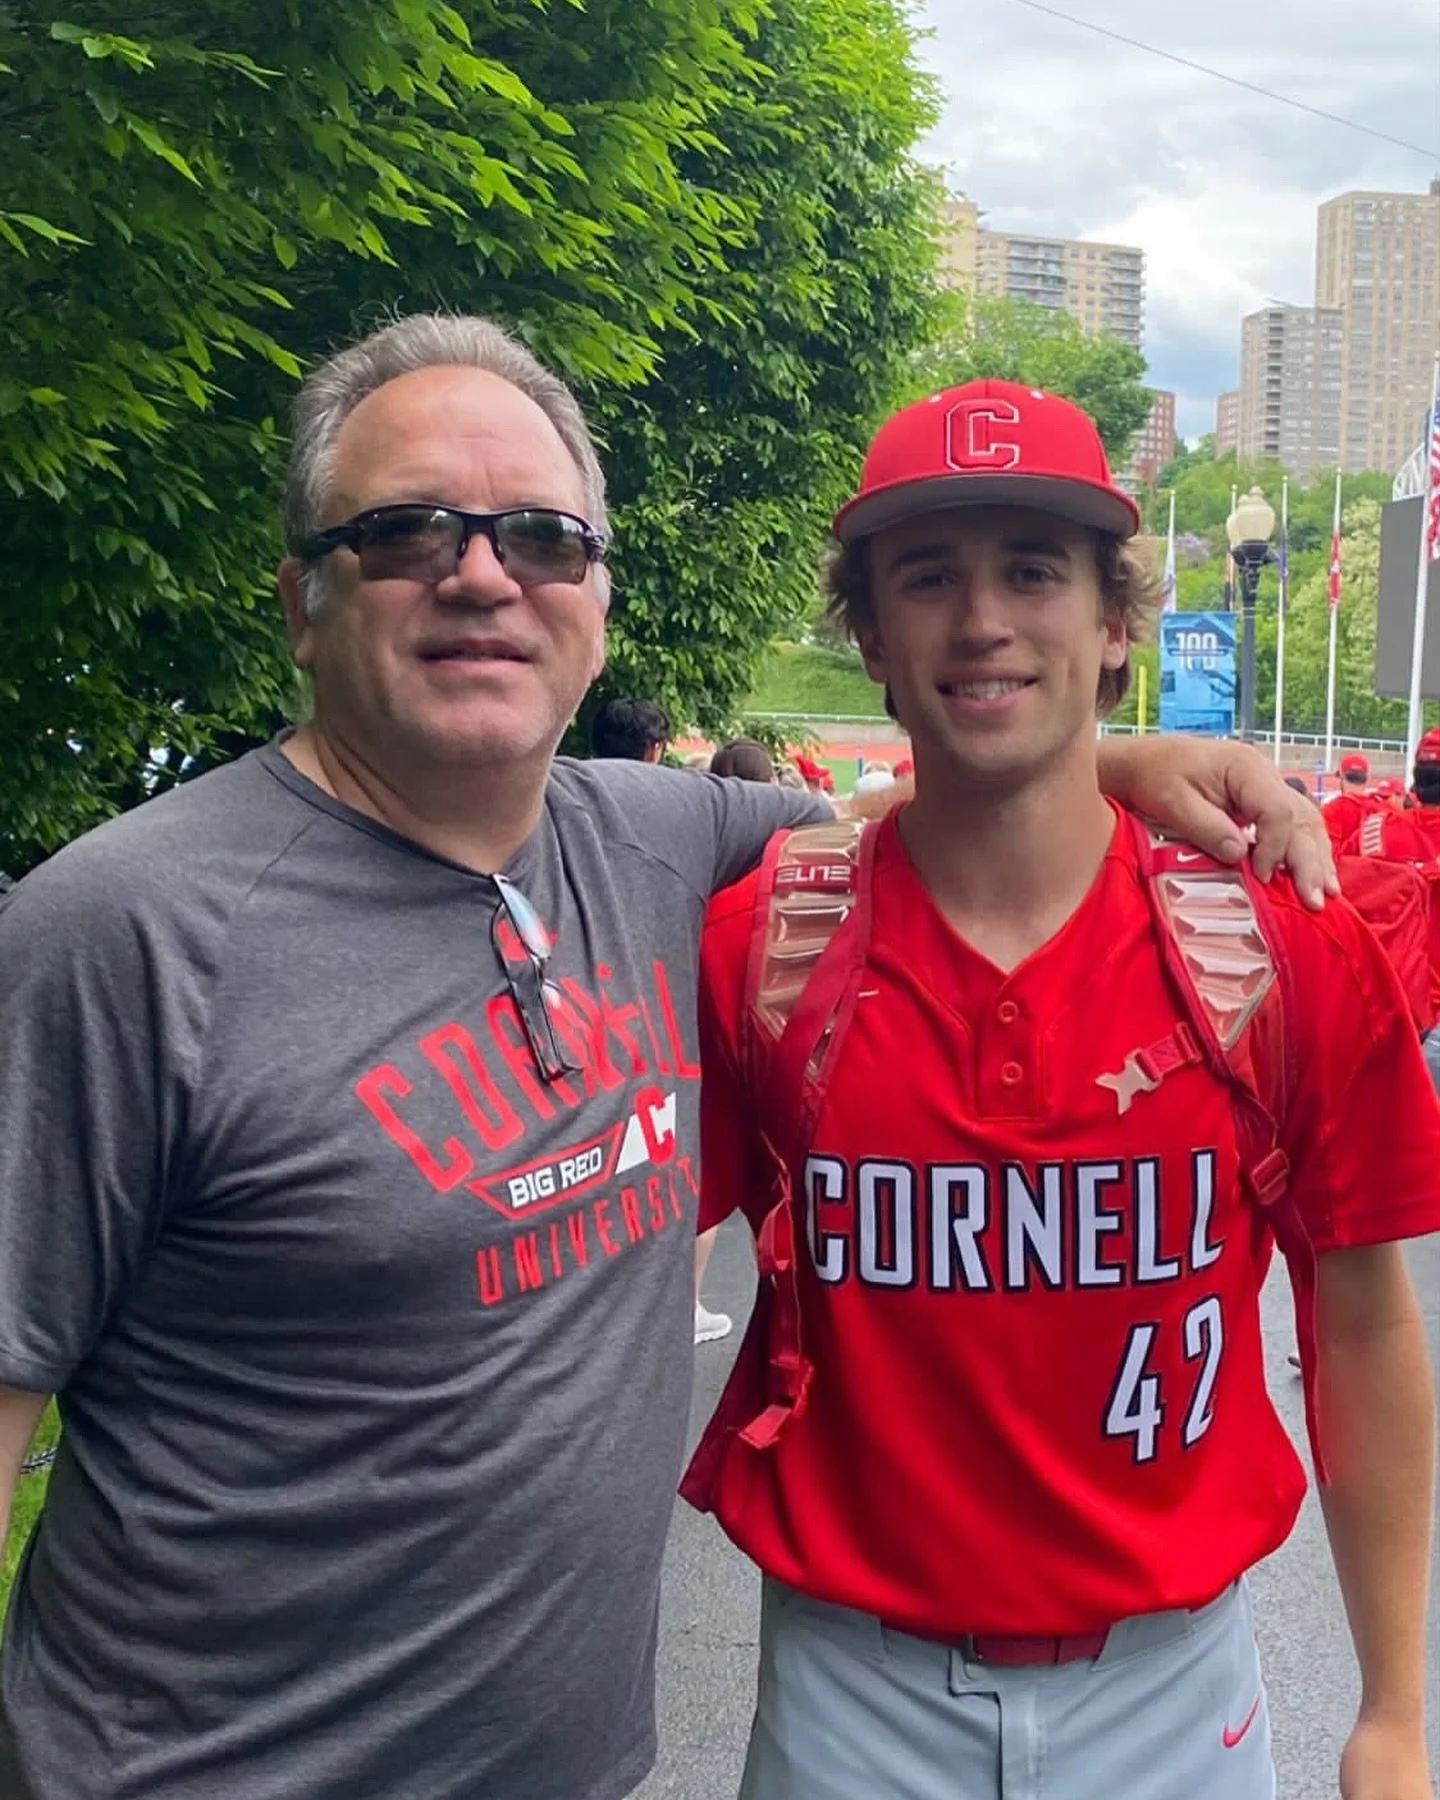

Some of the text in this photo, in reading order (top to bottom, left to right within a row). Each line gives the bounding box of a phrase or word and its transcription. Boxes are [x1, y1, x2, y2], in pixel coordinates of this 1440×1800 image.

[944, 398, 1020, 471] C
[776, 864, 851, 884] ELITE
[634, 1084, 676, 1166] C
[506, 1145, 603, 1209] BIG RED
[804, 1147, 1226, 1293] CORNELL
[1102, 1292, 1224, 1463] 42
